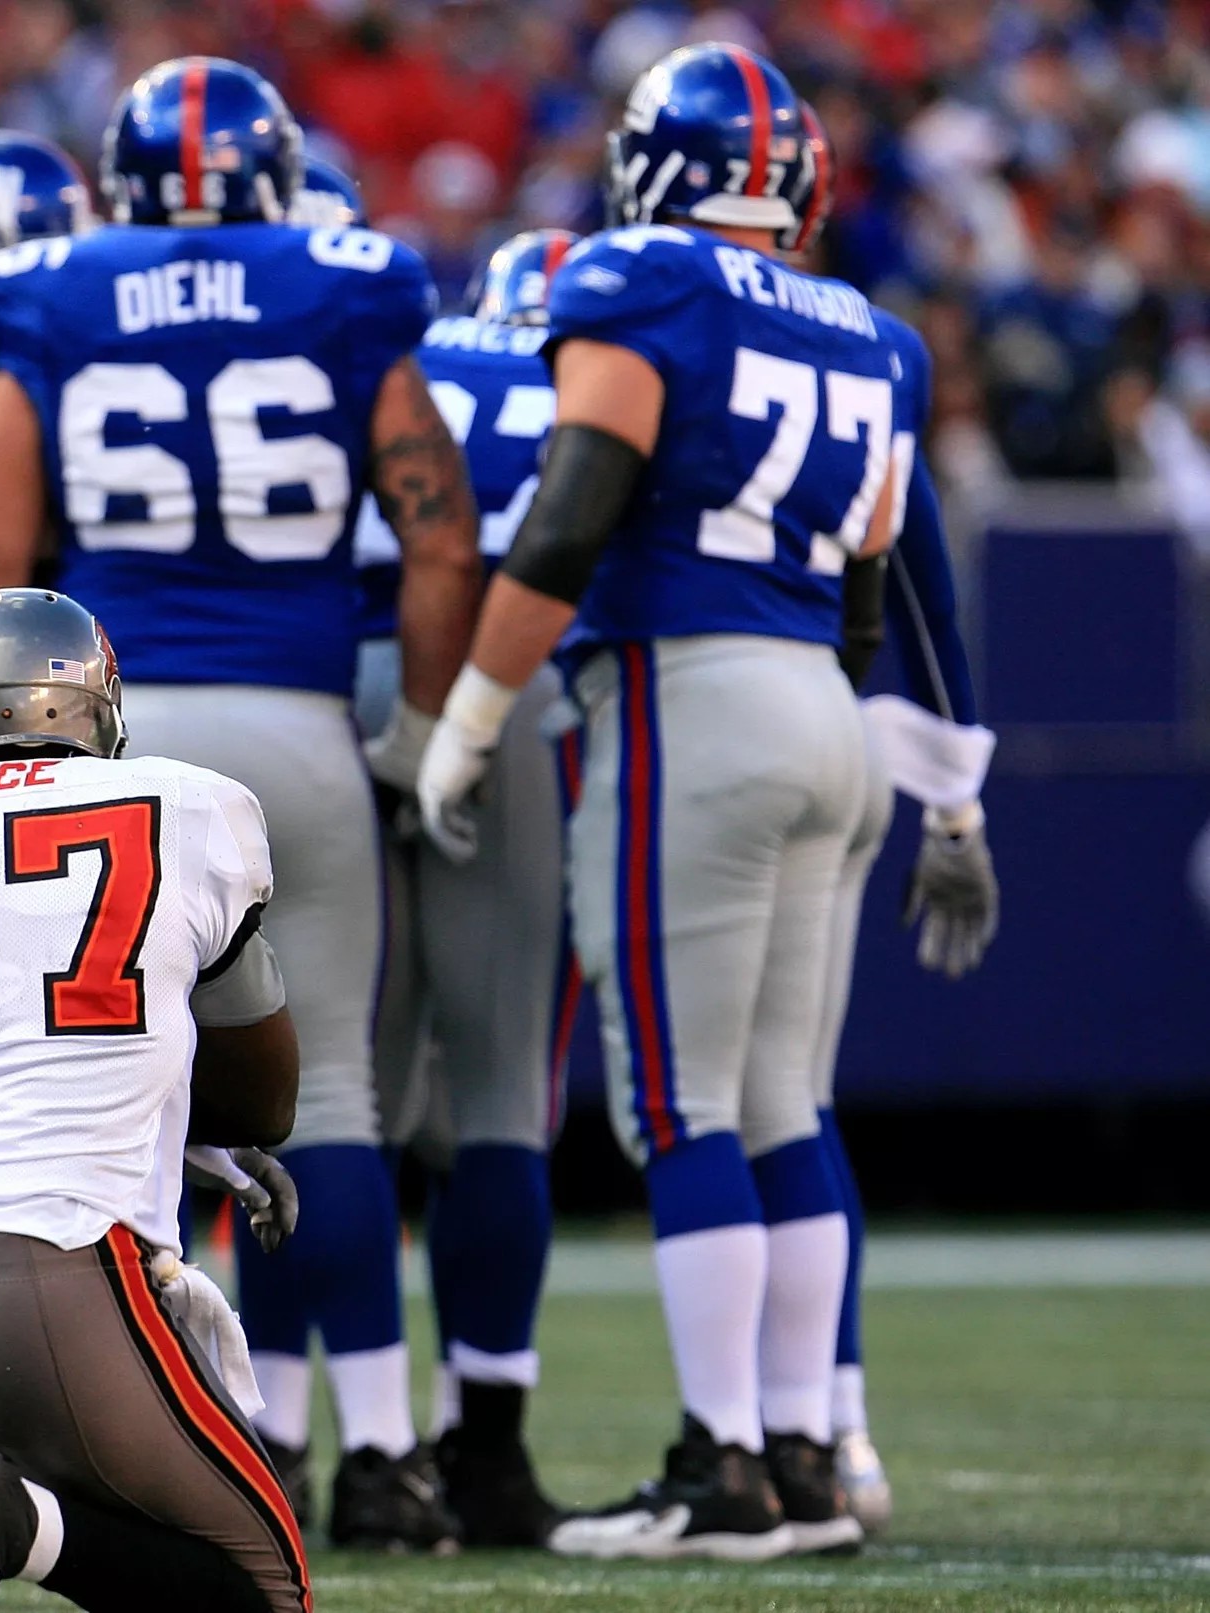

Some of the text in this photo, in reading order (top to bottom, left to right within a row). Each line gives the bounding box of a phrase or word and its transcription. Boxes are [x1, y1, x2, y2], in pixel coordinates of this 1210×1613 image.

[114, 259, 262, 335] DIEHL
[59, 356, 351, 562] 66
[696, 345, 892, 577] 77
